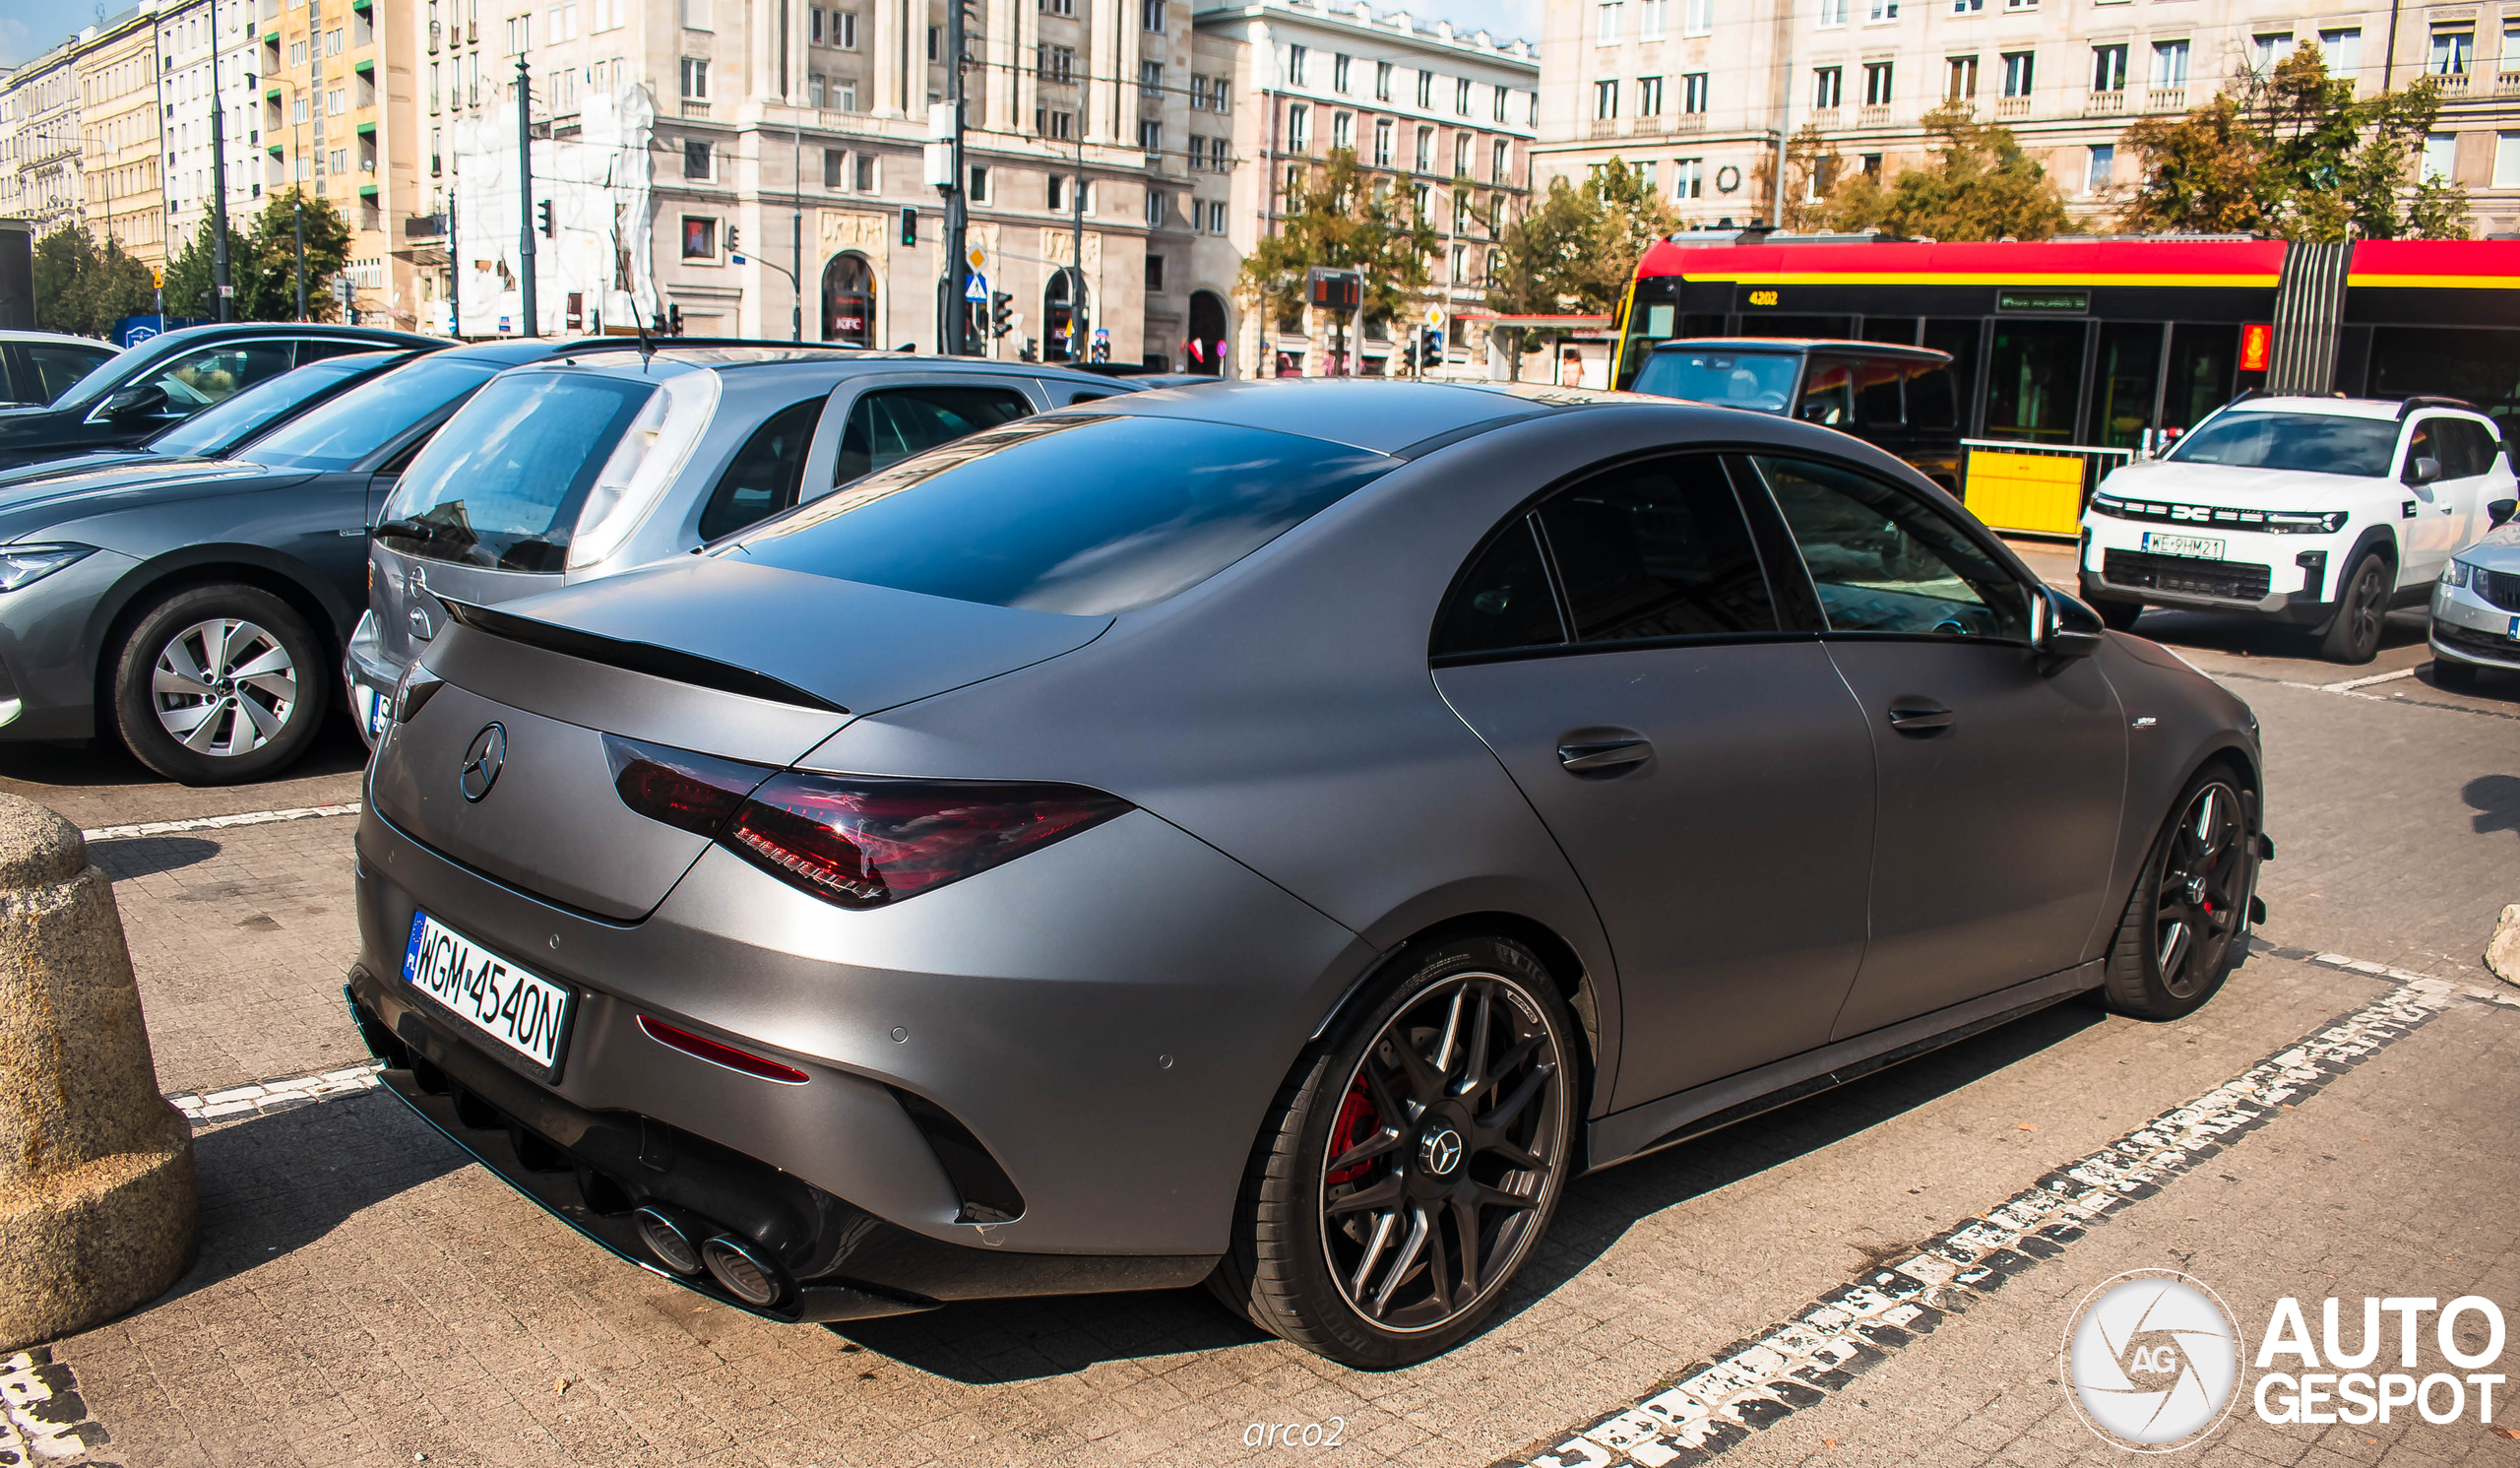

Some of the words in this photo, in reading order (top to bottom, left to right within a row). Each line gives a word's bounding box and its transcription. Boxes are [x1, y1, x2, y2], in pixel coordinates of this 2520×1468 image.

[1749, 290, 1778, 305] 4202
[836, 317, 861, 330] KFC
[406, 952, 415, 971] PL
[416, 924, 469, 1004] WGM
[469, 959, 564, 1060] 4540N
